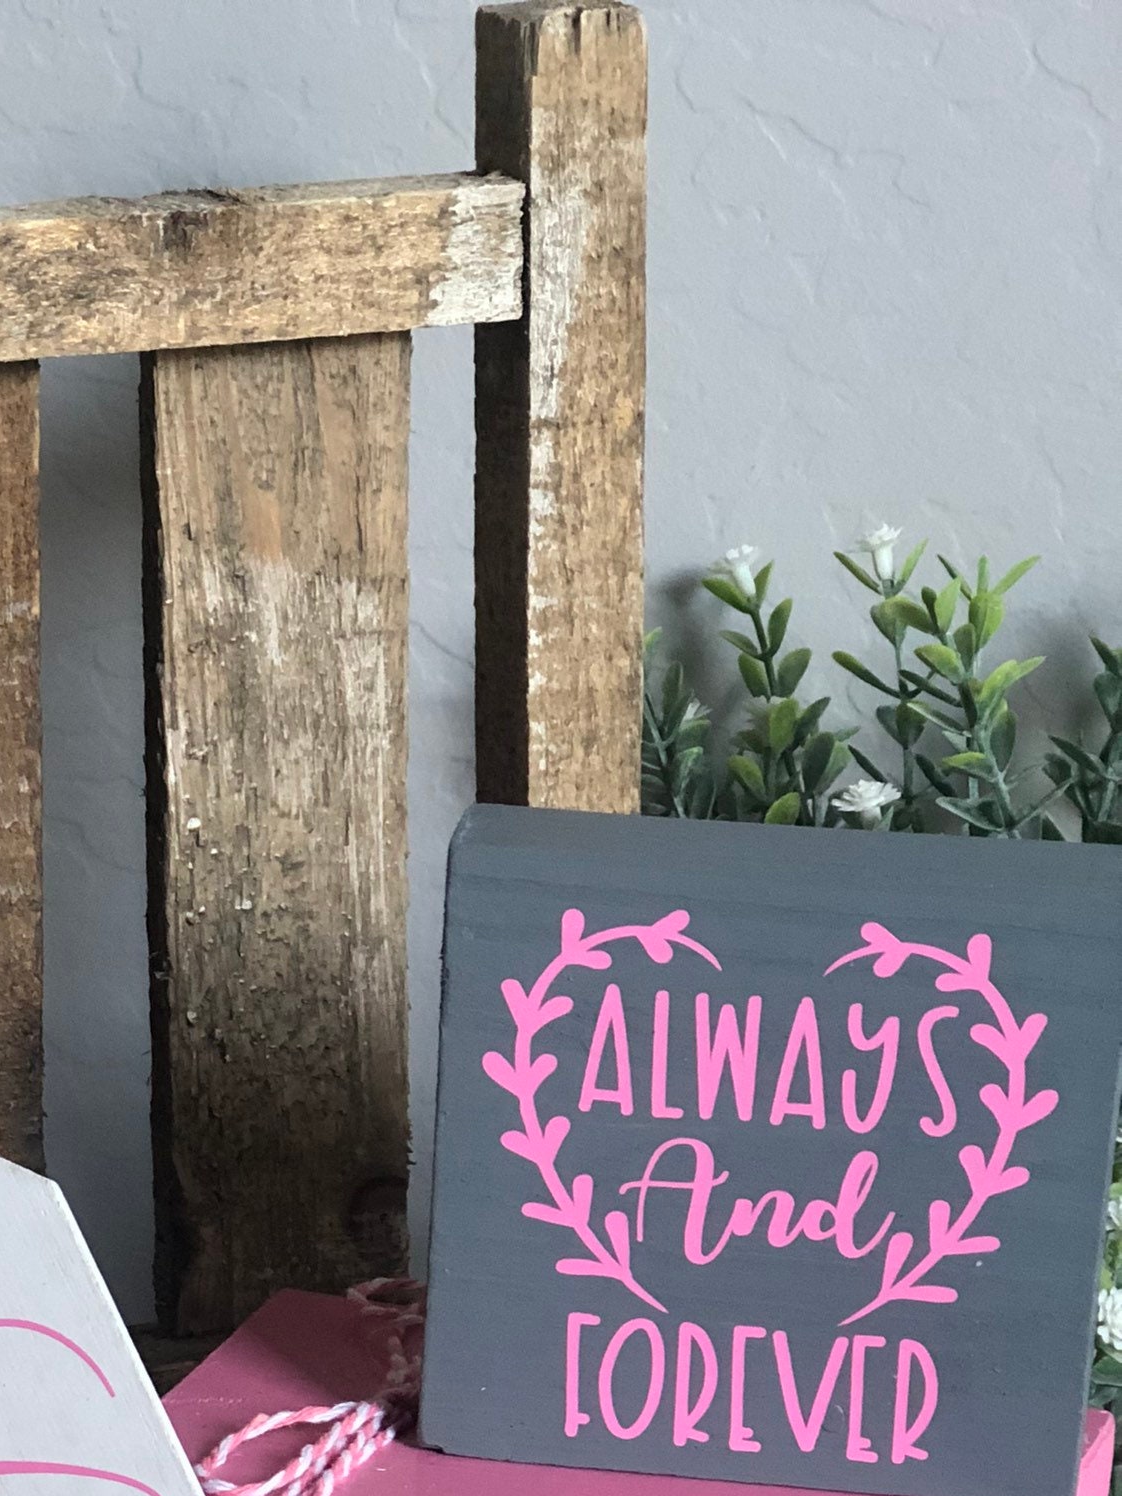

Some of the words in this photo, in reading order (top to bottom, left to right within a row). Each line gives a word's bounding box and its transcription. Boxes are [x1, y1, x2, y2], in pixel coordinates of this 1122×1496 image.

[579, 984, 959, 1137] ALWAYS
[619, 1137, 896, 1265] And
[564, 1312, 938, 1464] FOREVER
